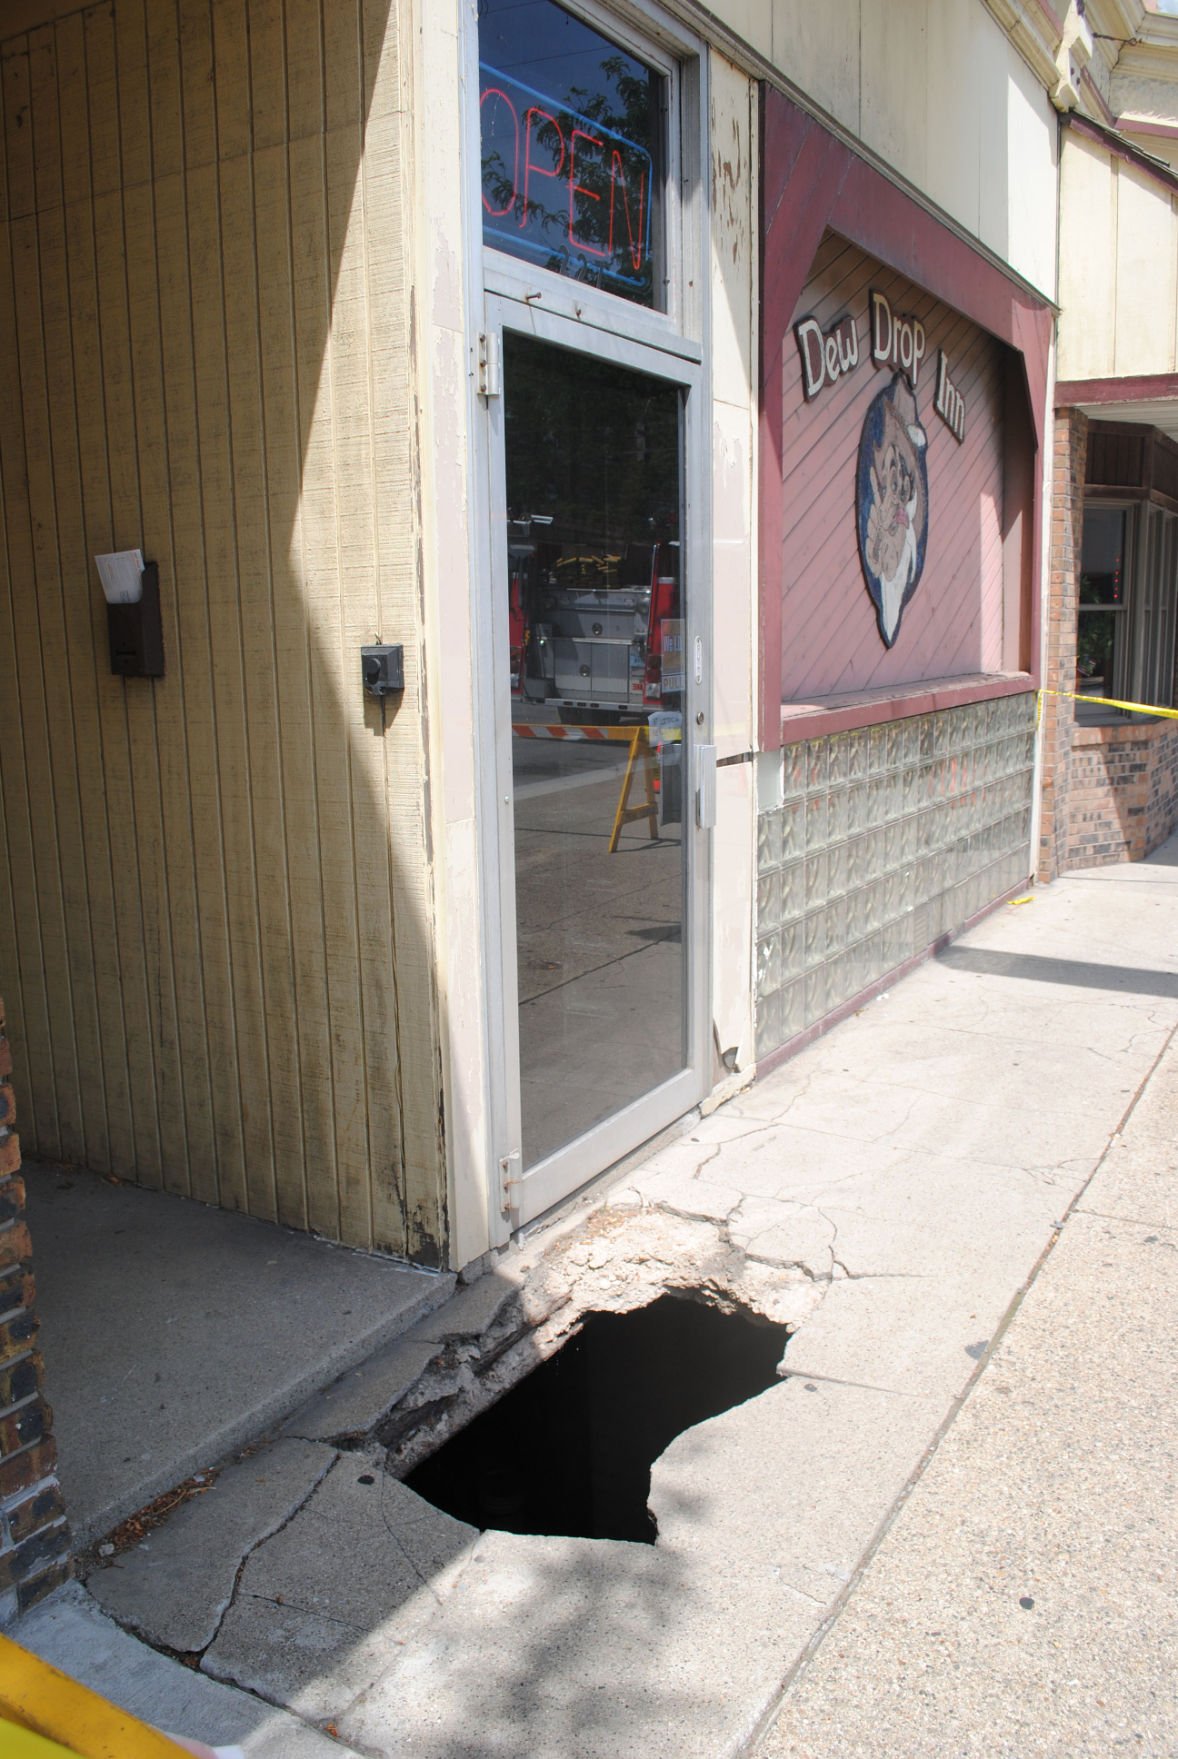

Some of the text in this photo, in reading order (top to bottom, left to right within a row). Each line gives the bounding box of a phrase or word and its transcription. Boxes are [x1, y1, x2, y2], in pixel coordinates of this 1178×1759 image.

[480, 87, 646, 270] OPEN
[798, 292, 965, 440] Dew Drop Inn
